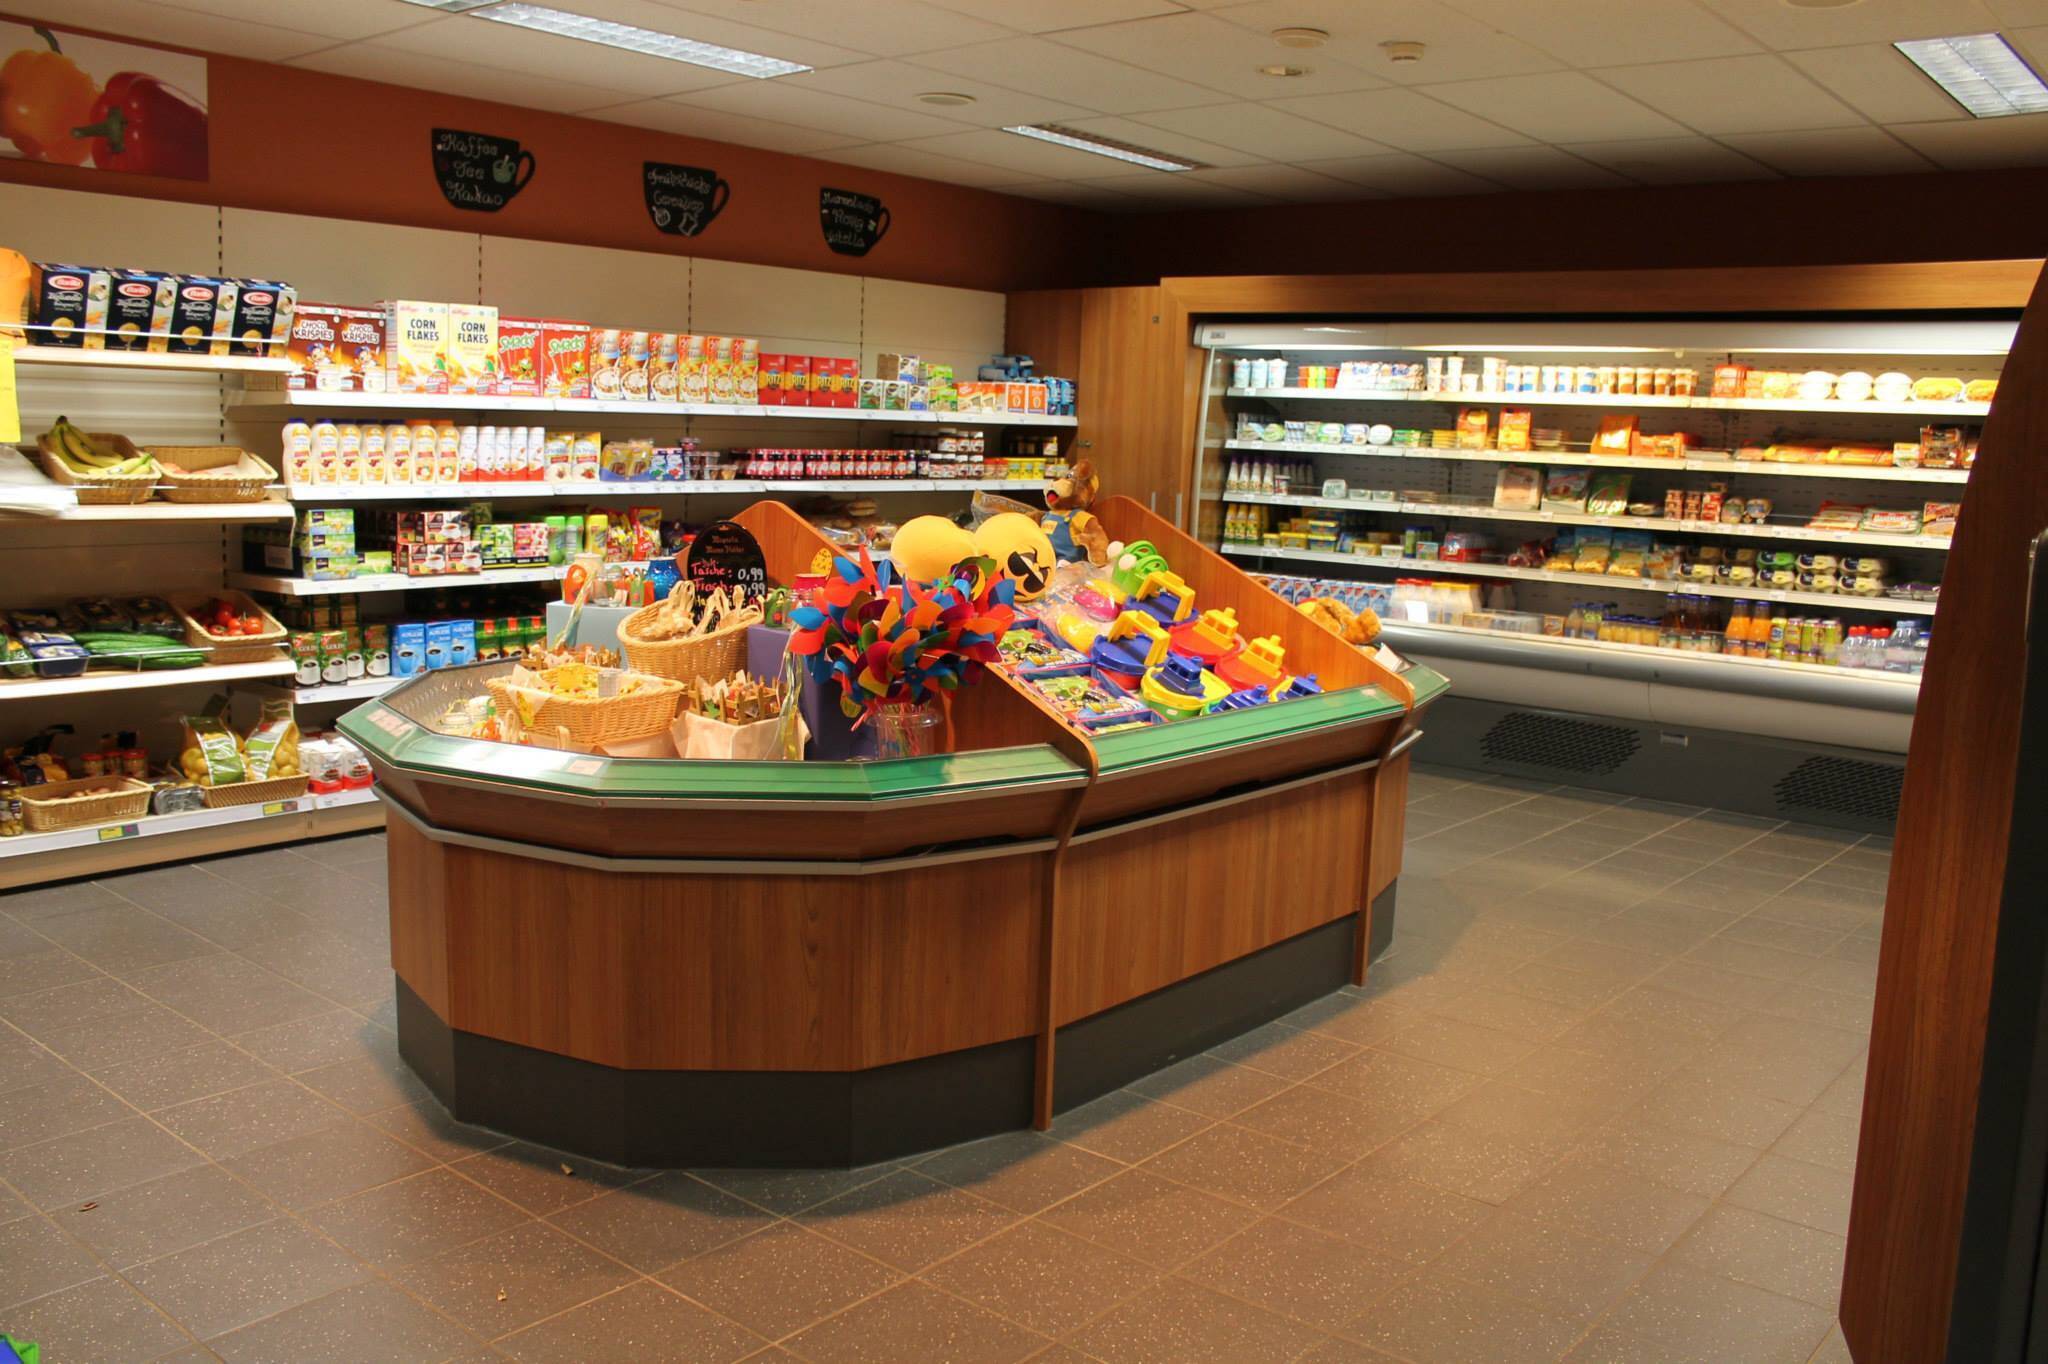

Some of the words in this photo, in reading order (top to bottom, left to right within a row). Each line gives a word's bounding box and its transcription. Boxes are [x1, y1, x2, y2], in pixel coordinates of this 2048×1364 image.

[410, 318, 436, 329] CORN
[461, 322, 486, 333] CORN
[295, 329, 334, 340] KRISPIES
[342, 332, 380, 343] KRISPIES
[407, 330, 440, 341] FLAKES
[457, 333, 489, 344] FLAKES
